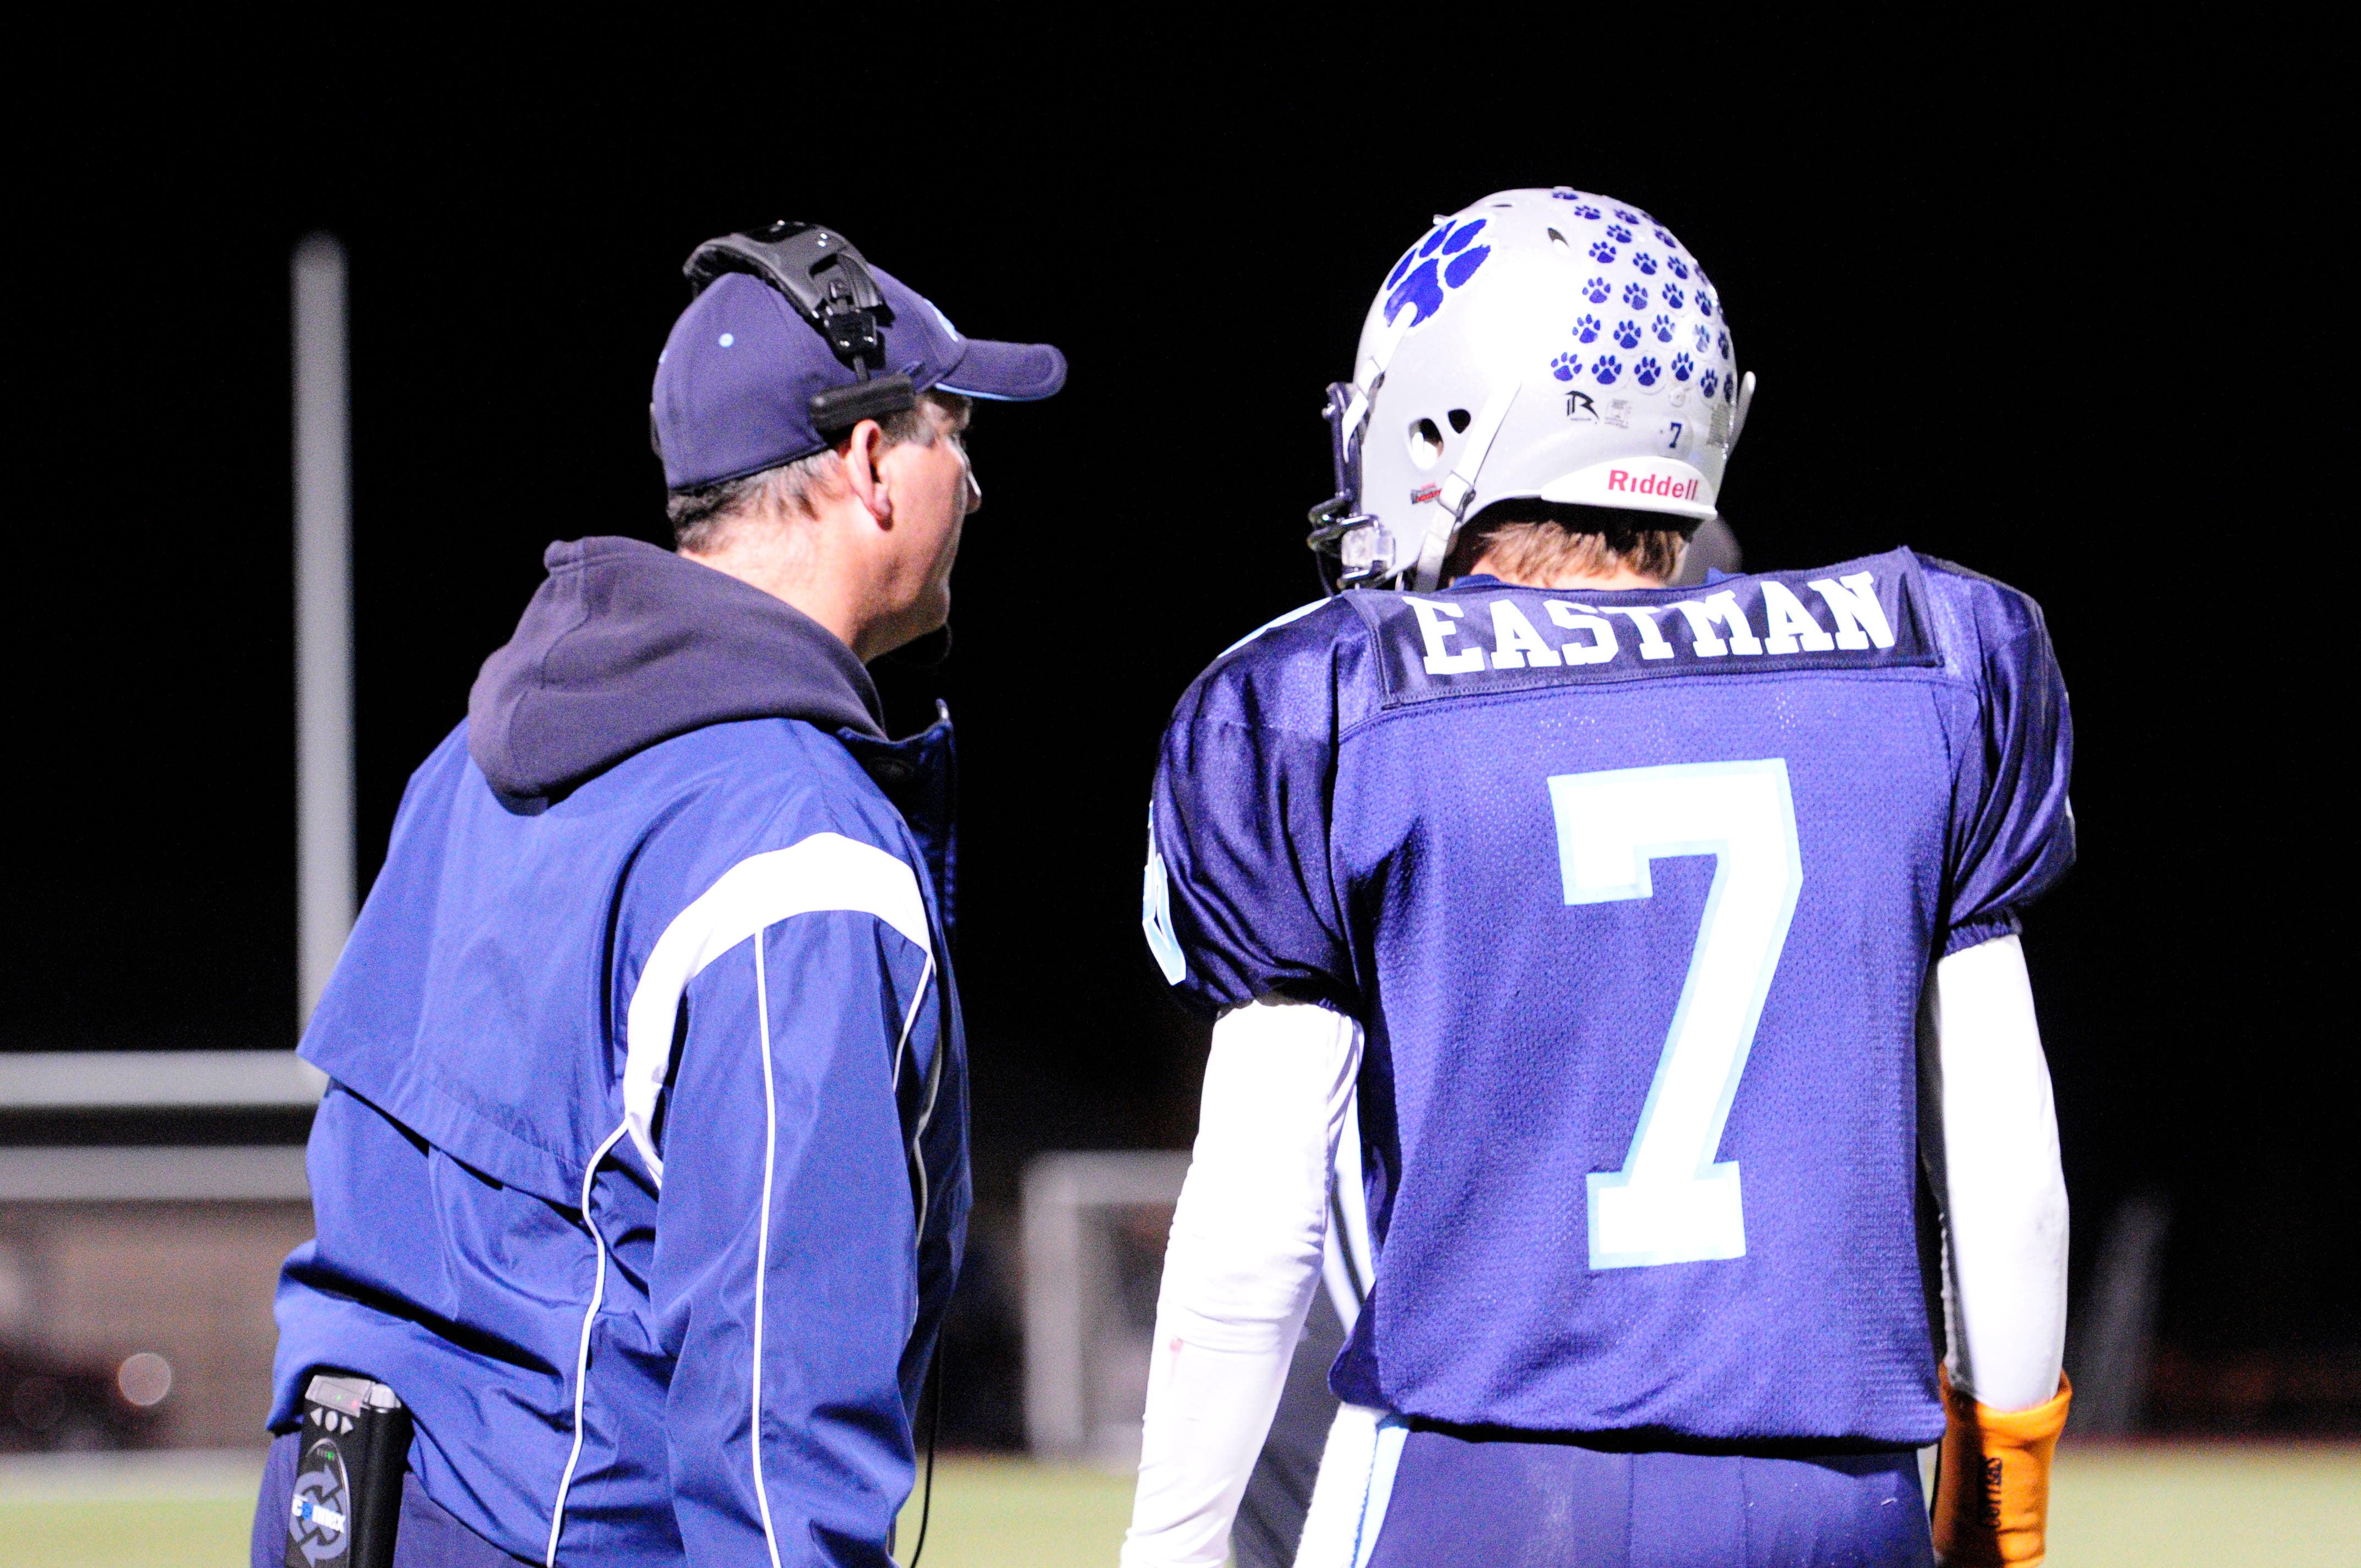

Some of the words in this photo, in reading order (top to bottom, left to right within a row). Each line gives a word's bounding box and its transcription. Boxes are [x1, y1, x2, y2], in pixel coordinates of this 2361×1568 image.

[1669, 422, 1682, 448] 7
[1608, 469, 1699, 501] Riddell
[1402, 570, 1895, 675] EASTMAN
[1547, 757, 1803, 1270] 7
